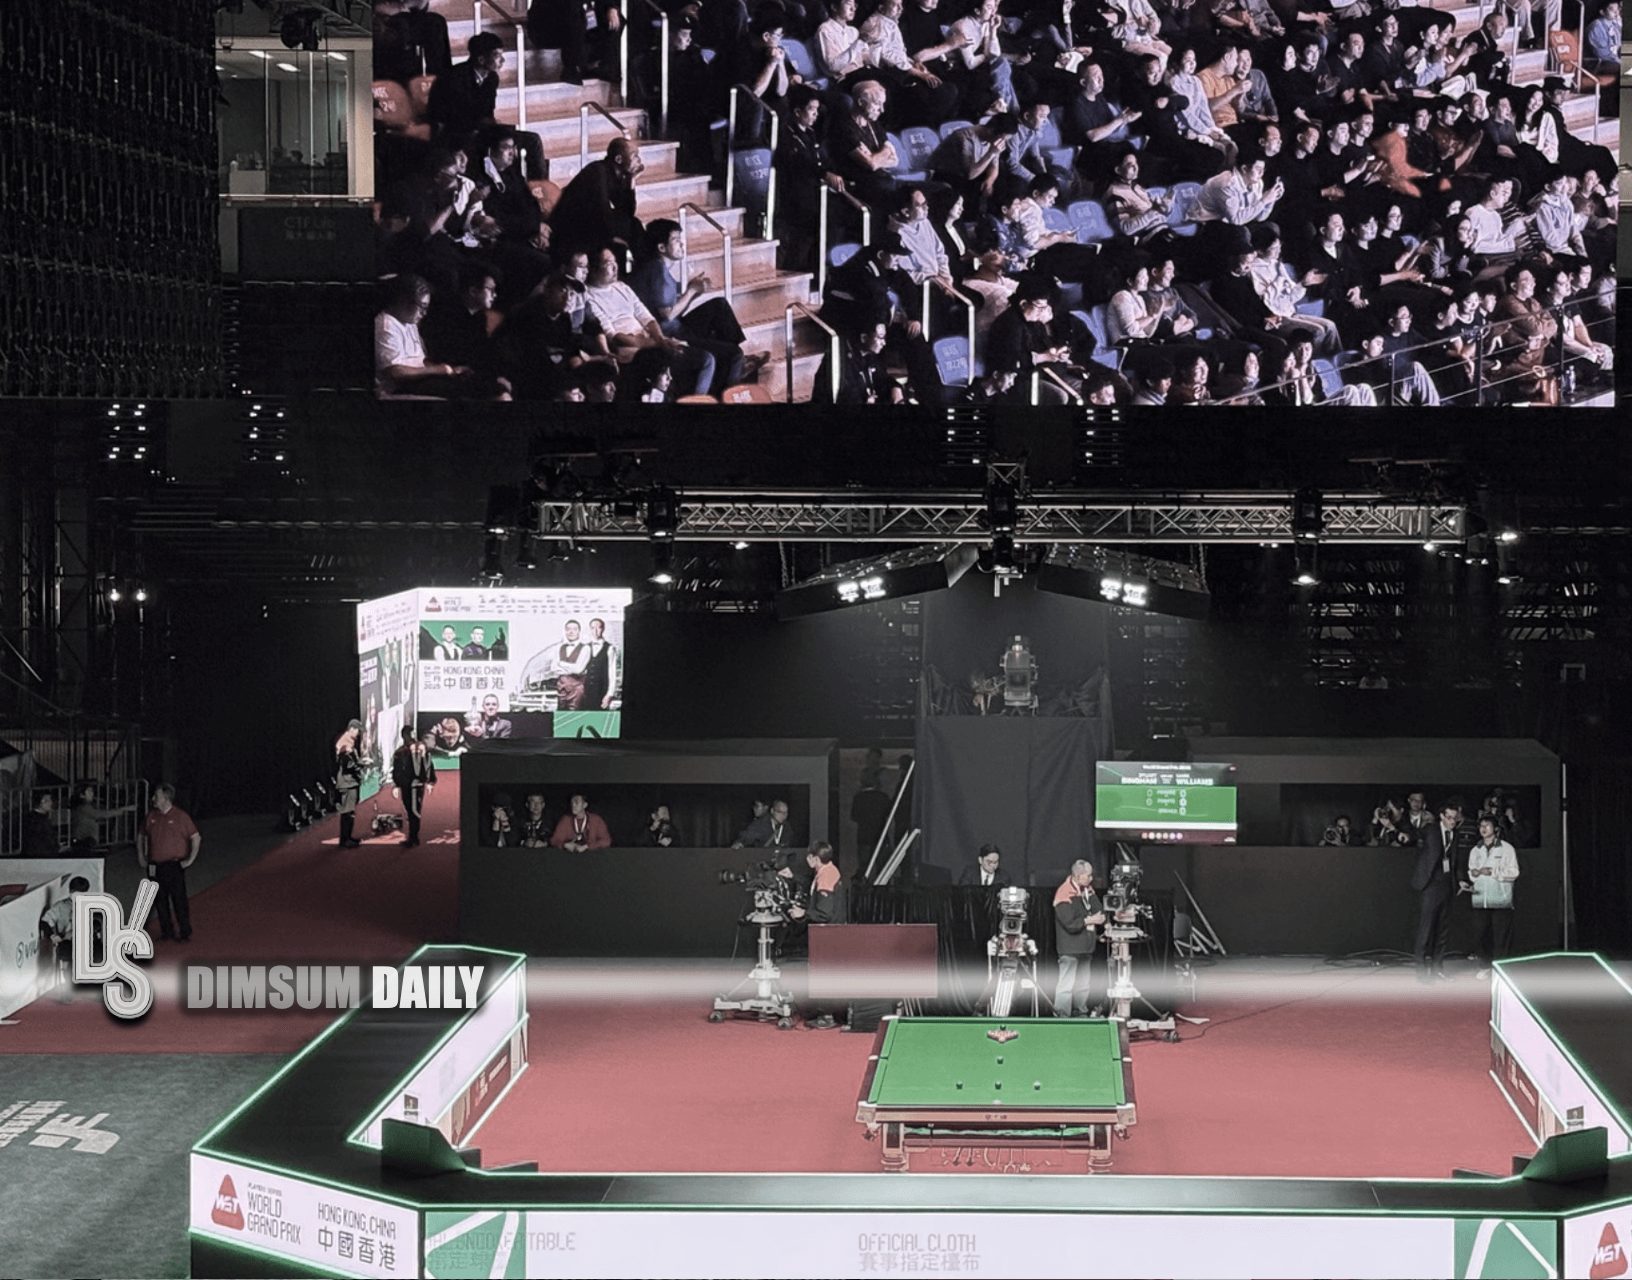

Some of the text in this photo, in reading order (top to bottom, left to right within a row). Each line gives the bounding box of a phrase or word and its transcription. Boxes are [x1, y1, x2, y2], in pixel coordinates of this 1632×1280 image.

[248, 1191, 282, 1218] WORLD
[247, 1212, 301, 1245] GRAND PRIX
[318, 1202, 396, 1240] HONG KONG, CHINA
[318, 1226, 396, 1271] 中國香港
[529, 1232, 576, 1251] TABLE
[858, 1232, 976, 1252] OFFICIAL CLOTH
